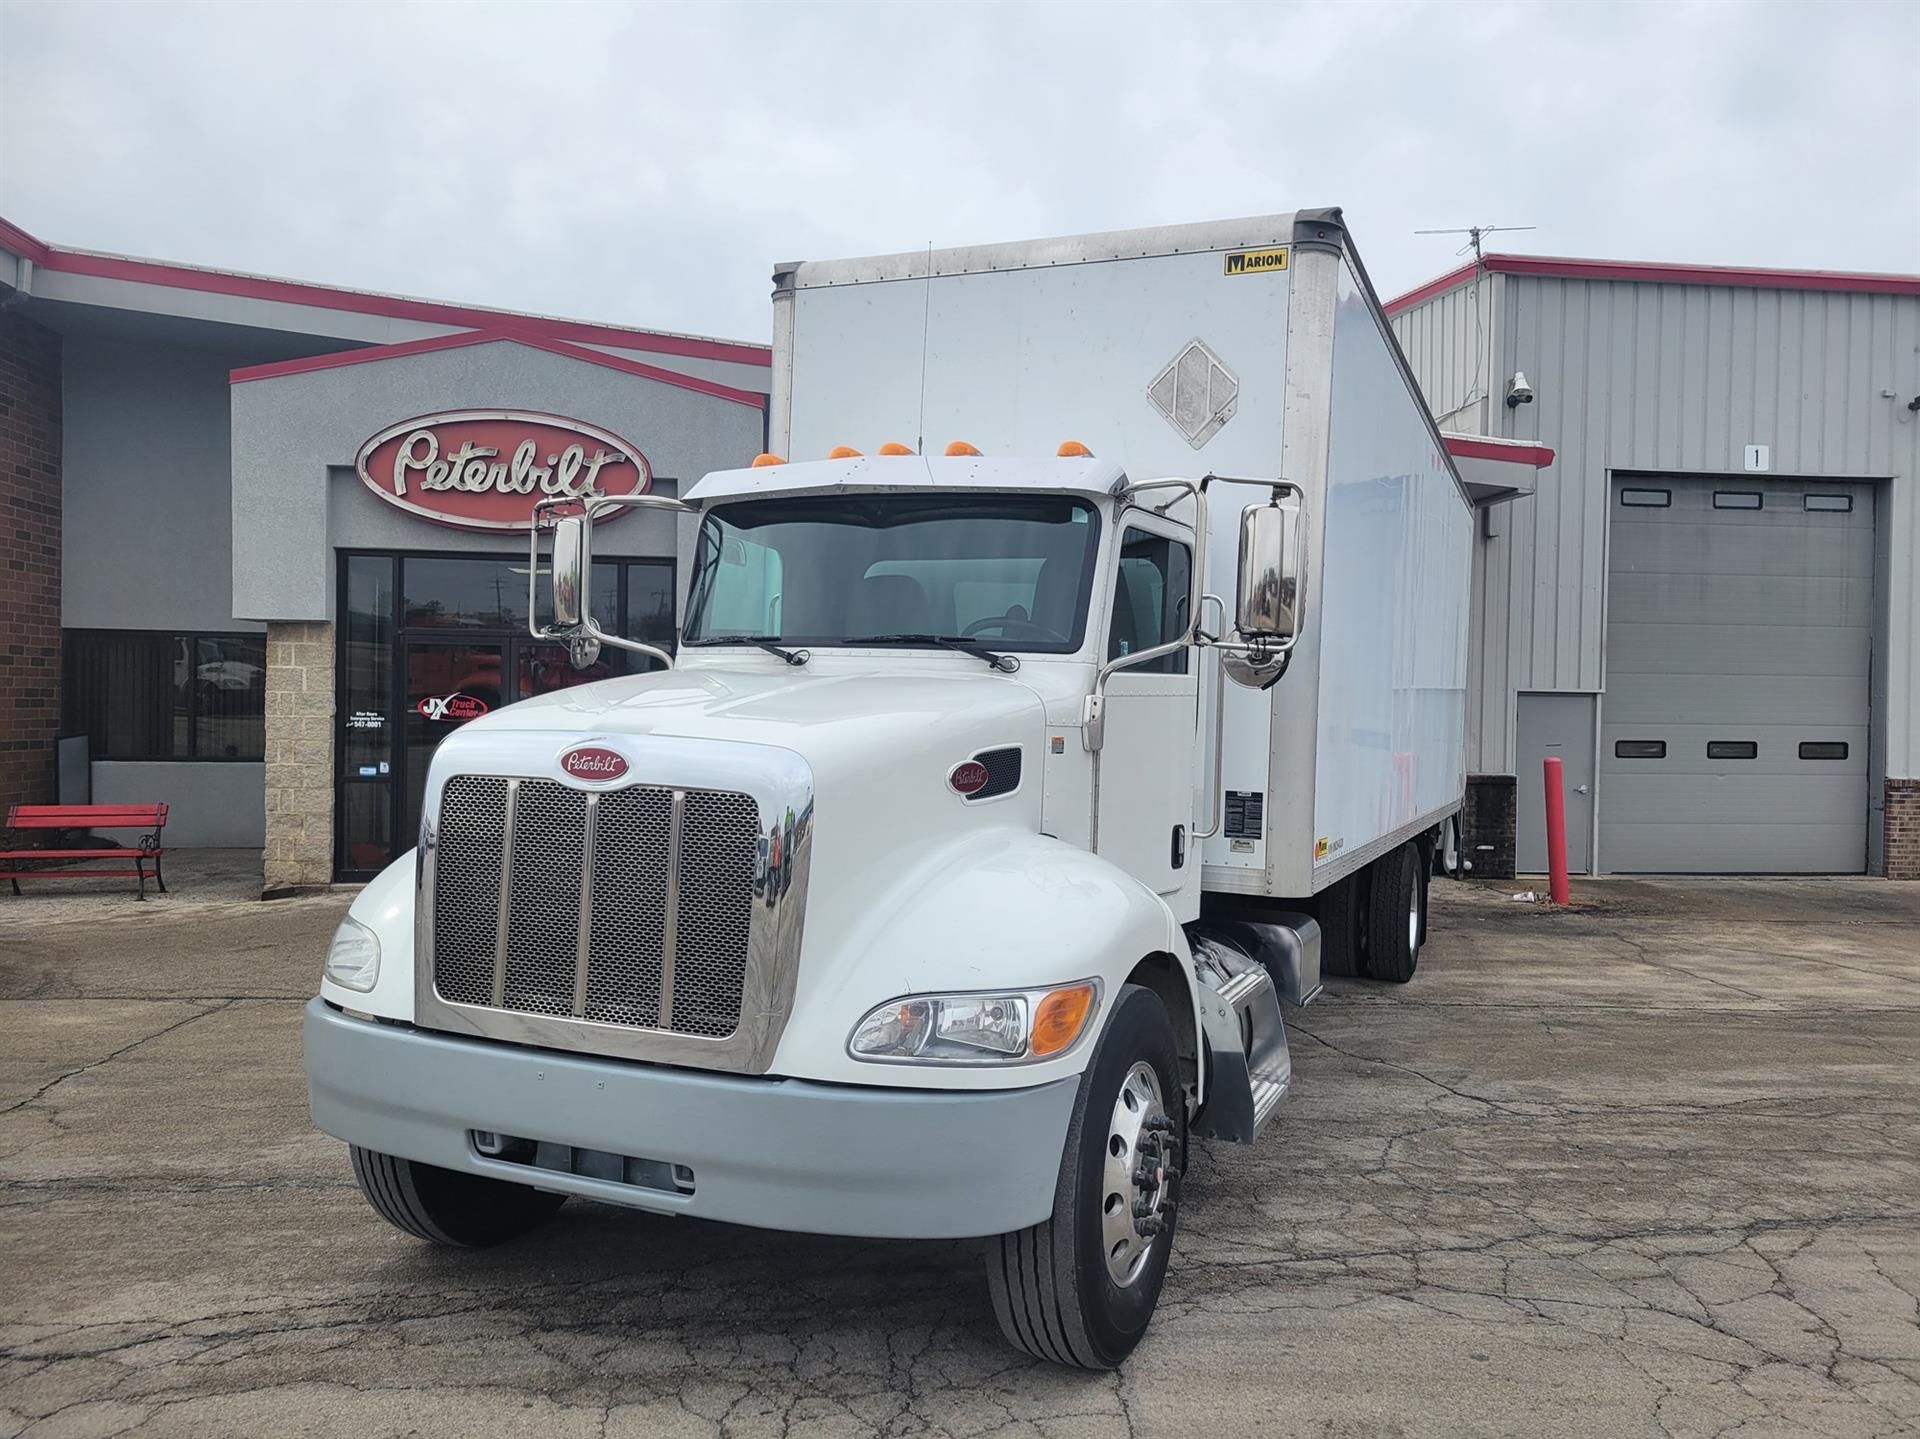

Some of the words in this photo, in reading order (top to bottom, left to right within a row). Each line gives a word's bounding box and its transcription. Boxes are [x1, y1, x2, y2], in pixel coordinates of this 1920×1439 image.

[1227, 254, 1283, 273] MARION
[394, 430, 626, 497] Peterbilt
[1755, 449, 1759, 467] 1
[423, 692, 461, 720] JX
[449, 708, 478, 718] Center
[452, 699, 476, 709] Truck
[567, 752, 622, 772] Peterbilt
[955, 768, 985, 786] Peterbilt
